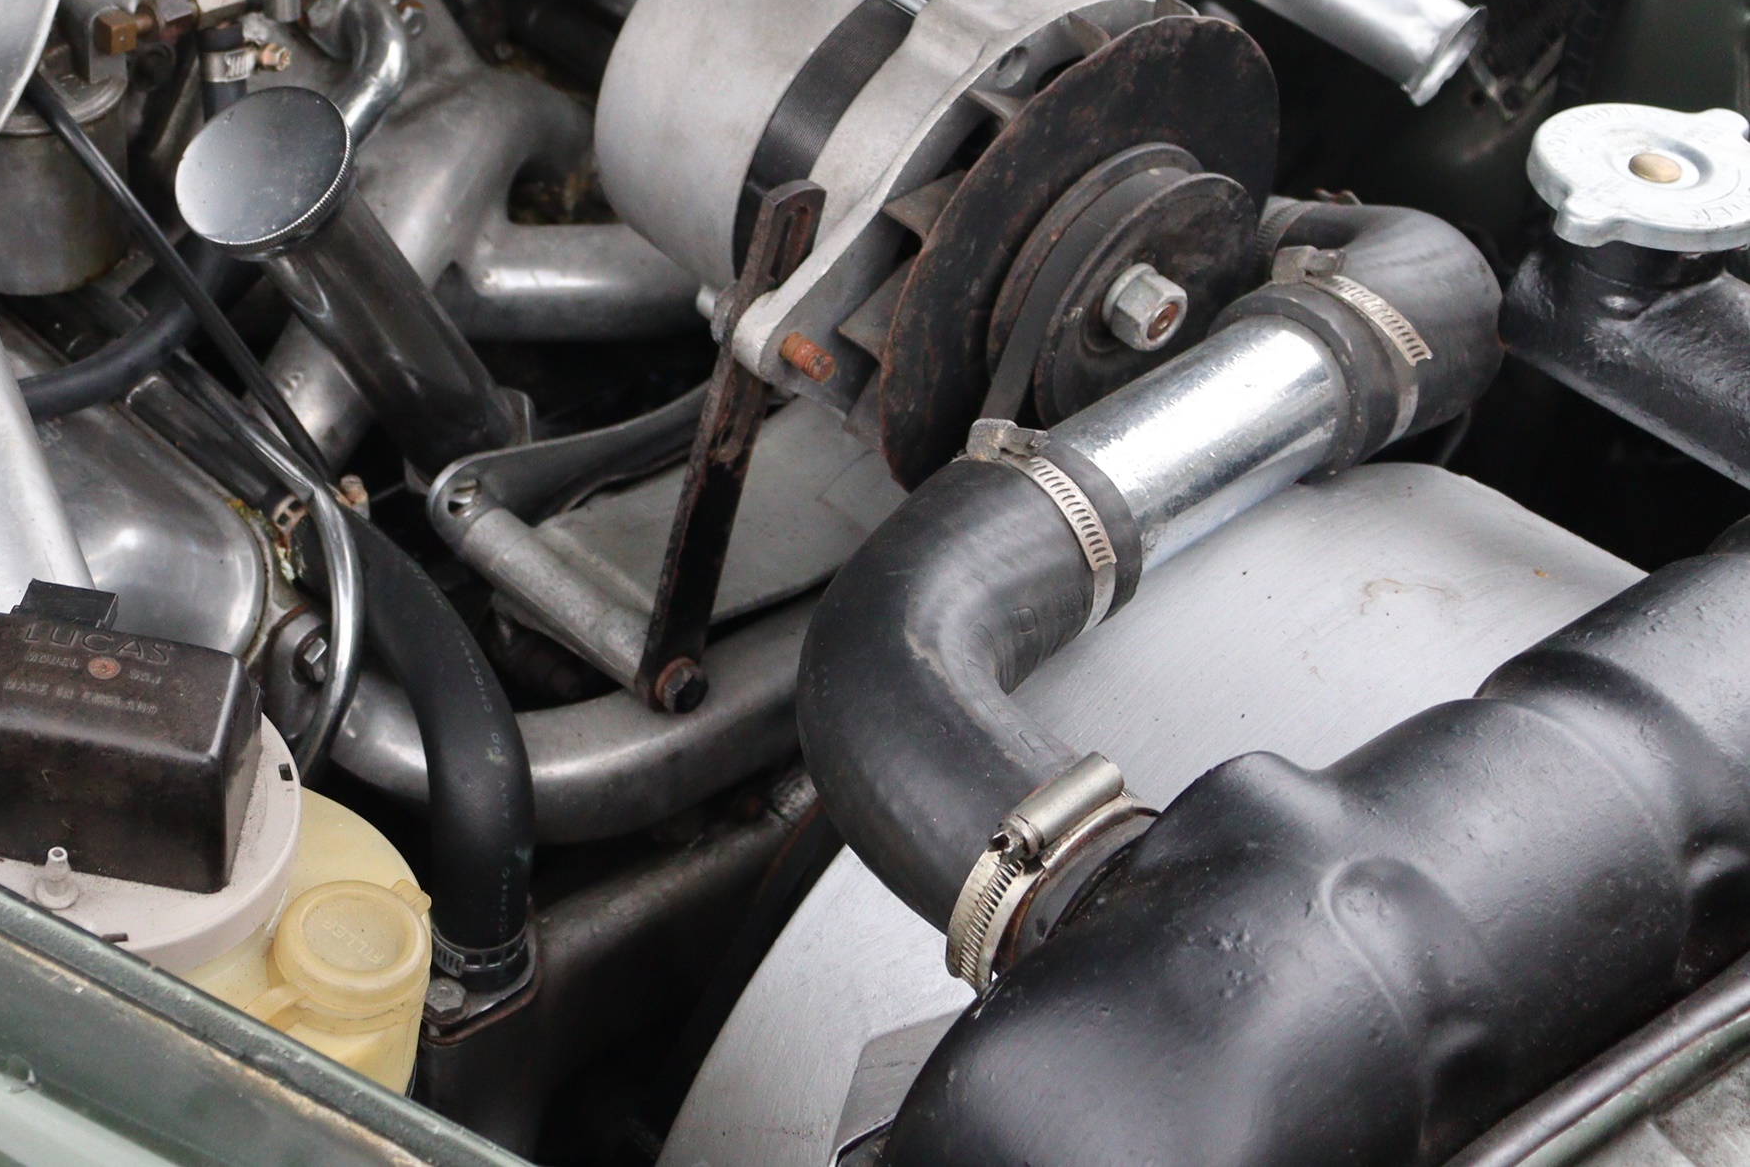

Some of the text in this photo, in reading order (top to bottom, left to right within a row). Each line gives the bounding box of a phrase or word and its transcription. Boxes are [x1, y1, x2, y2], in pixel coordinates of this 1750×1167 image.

[23, 623, 174, 666] LUCAS
[24, 651, 79, 670] MODEL
[4, 679, 159, 715] MADE IN ENGLAND
[322, 920, 386, 964] FILLER
